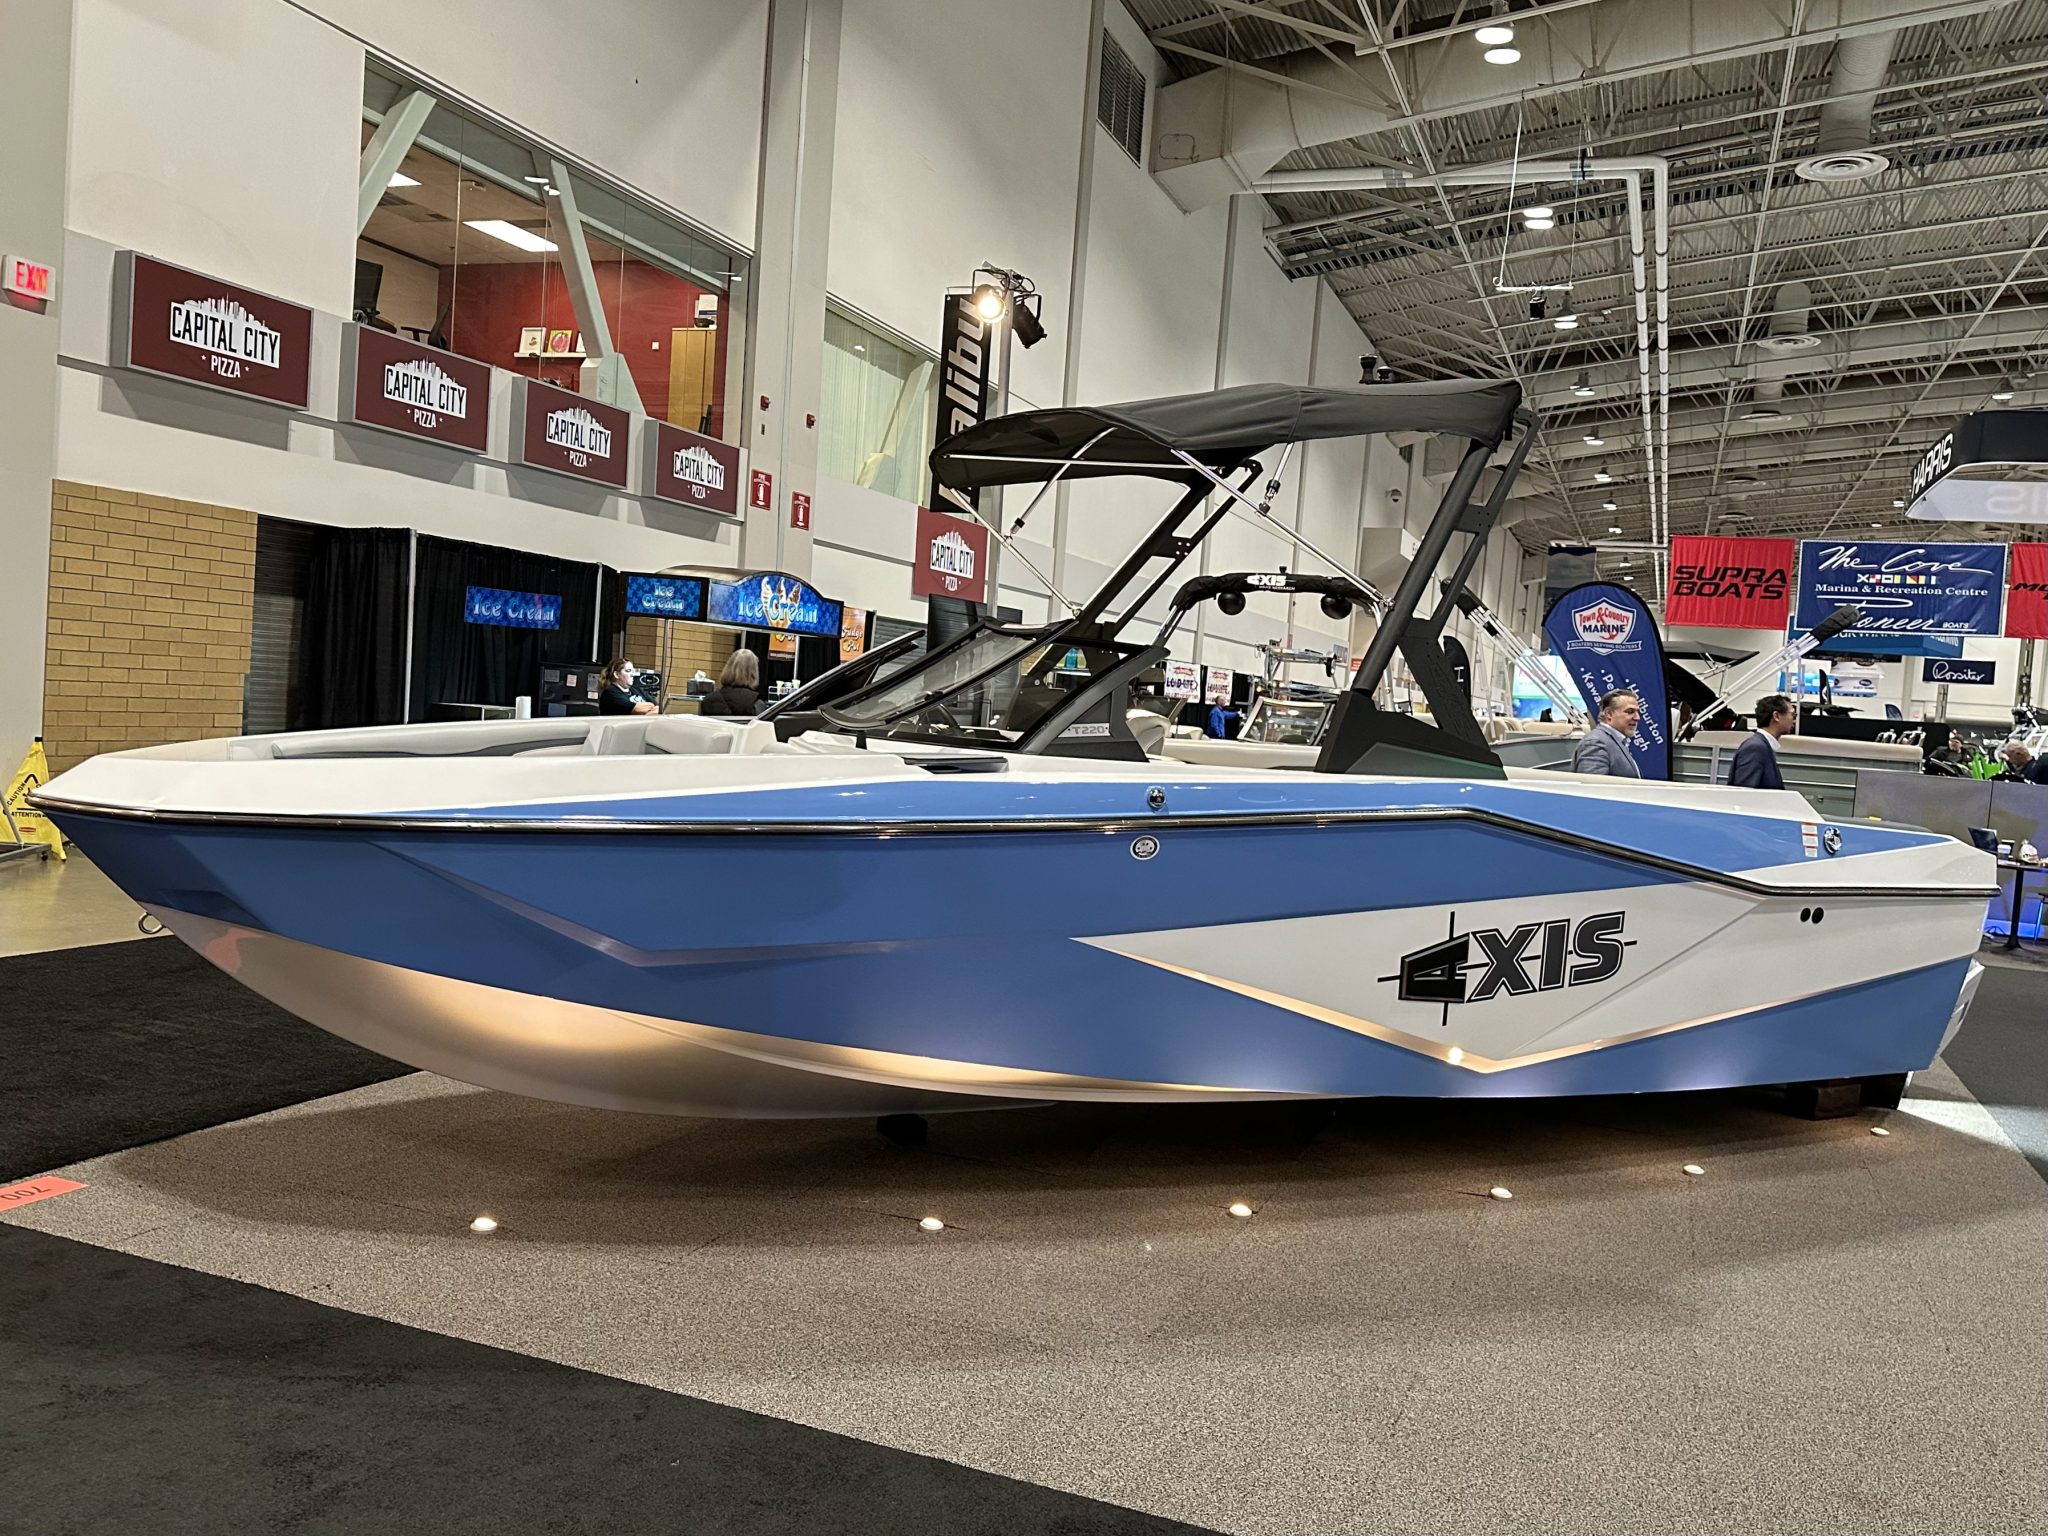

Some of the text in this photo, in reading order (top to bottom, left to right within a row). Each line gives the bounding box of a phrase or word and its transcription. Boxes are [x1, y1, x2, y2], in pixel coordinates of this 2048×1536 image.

[16, 260, 48, 295] EXIT
[172, 306, 278, 363] CAPITAL CITY
[211, 355, 240, 378] PIZZA
[386, 368, 464, 414] CAPITAL CITY
[414, 409, 436, 428] PIZZA
[548, 416, 609, 454] CAPITAL CITY
[569, 451, 587, 467] PIZZA
[1911, 433, 1953, 499] HARRIS
[675, 454, 704, 482] CAPITAL
[707, 464, 723, 487] CITY
[691, 484, 706, 498] PIZZA
[931, 543, 973, 575] CAPITAL CITY
[1819, 546, 1994, 575] The Cove
[1246, 575, 1287, 586] AXIS
[1673, 565, 1787, 584] SUPRA
[655, 583, 675, 597] Ice
[1673, 581, 1785, 600] BOATS
[1815, 584, 1988, 596] Marina & Recreation Centre
[474, 592, 555, 621] Ice Cream
[642, 594, 684, 611] Cream
[738, 591, 818, 623] Ice Cream
[1579, 607, 1629, 627] Town & Country
[1582, 625, 1626, 633] MARINE
[1932, 661, 1985, 681] Rossiter
[1072, 725, 1105, 735] T220
[7, 783, 26, 806] CAUTION
[1398, 911, 1626, 1004] AXIS
